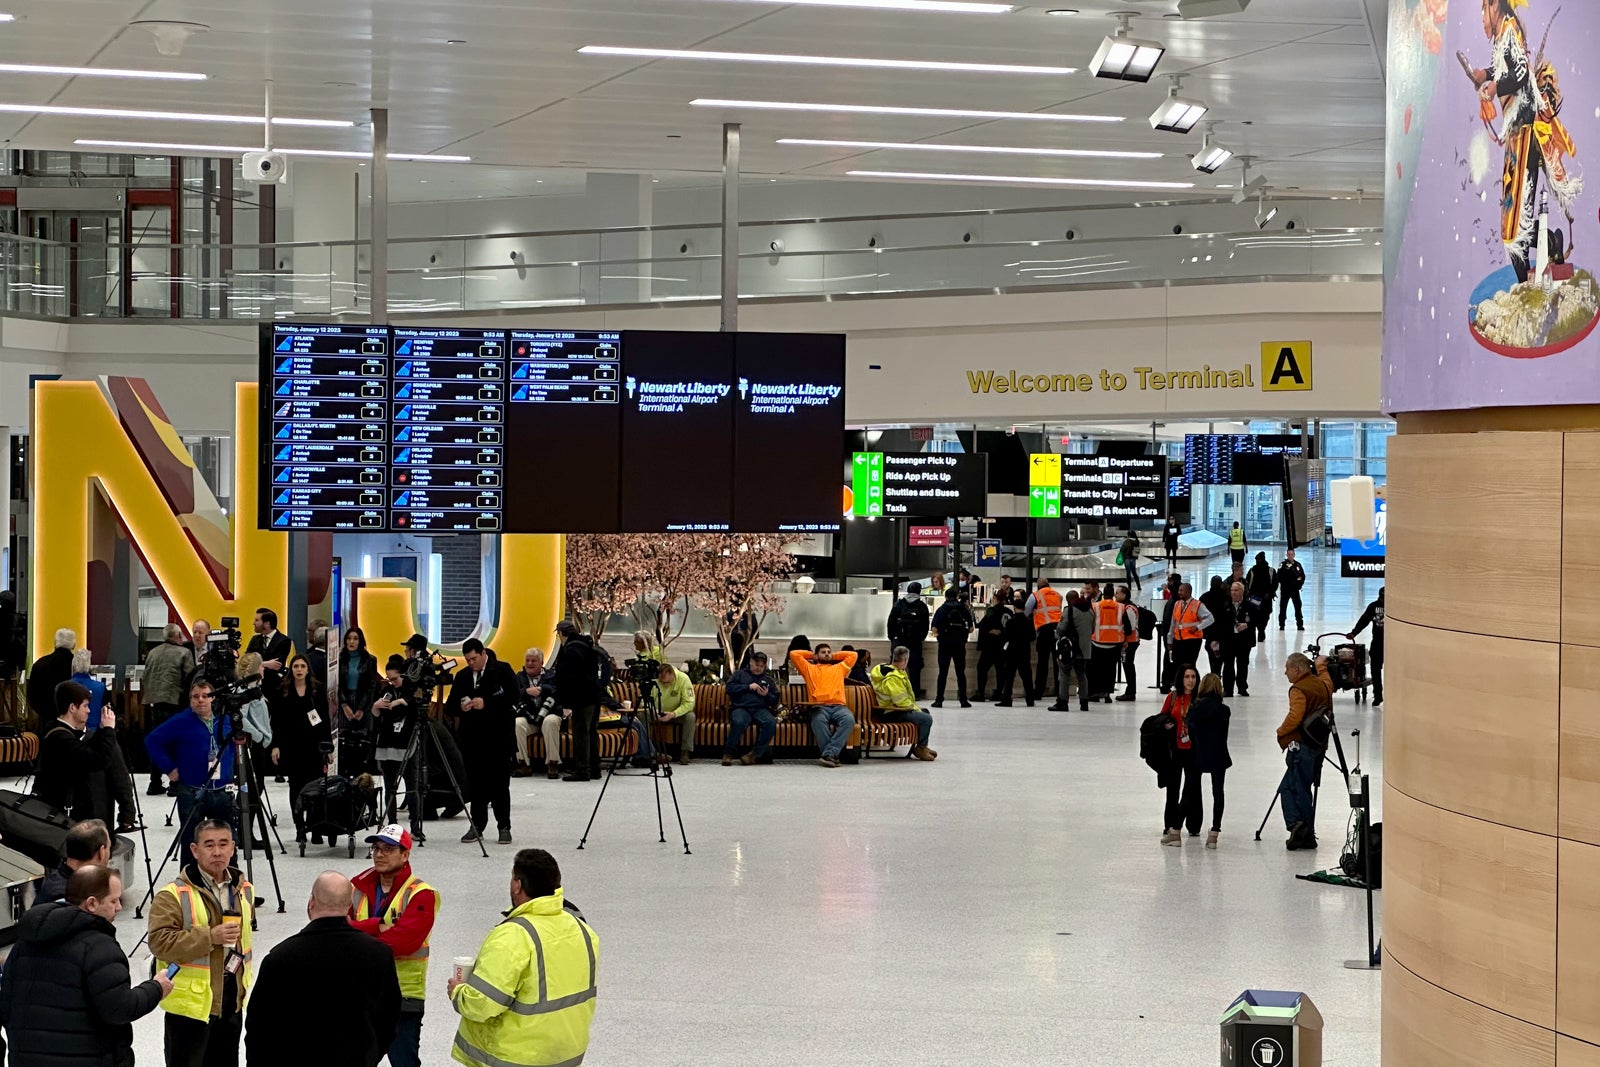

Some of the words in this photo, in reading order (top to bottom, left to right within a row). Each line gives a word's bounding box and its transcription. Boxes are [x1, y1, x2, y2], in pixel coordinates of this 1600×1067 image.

[966, 369, 1093, 393] Welcome
[1099, 368, 1127, 391] to
[1134, 363, 1254, 390] Terminal
[1269, 346, 1305, 385] A
[640, 382, 686, 394] Newark
[687, 383, 730, 396] Liberty
[752, 384, 798, 395] Newark
[798, 384, 841, 397] Liberty
[640, 395, 691, 403] International
[691, 395, 718, 404] Airport
[752, 396, 801, 404] International
[802, 396, 829, 405] Airport
[639, 403, 676, 412] Terminal
[751, 404, 788, 413] Terminal
[886, 456, 926, 466] Passenger
[946, 457, 957, 466] Up
[1064, 458, 1098, 466] Terminal
[1110, 458, 1154, 468] Departures
[904, 472, 920, 482] App
[940, 473, 951, 482] Up
[1064, 474, 1102, 482] Terminals
[886, 488, 918, 496] Shuttles
[919, 488, 934, 497] and
[935, 489, 959, 497] Buses
[1064, 490, 1091, 498] Transit
[1102, 490, 1118, 500] City
[886, 504, 907, 512] Taxis
[1063, 506, 1092, 516] Parking
